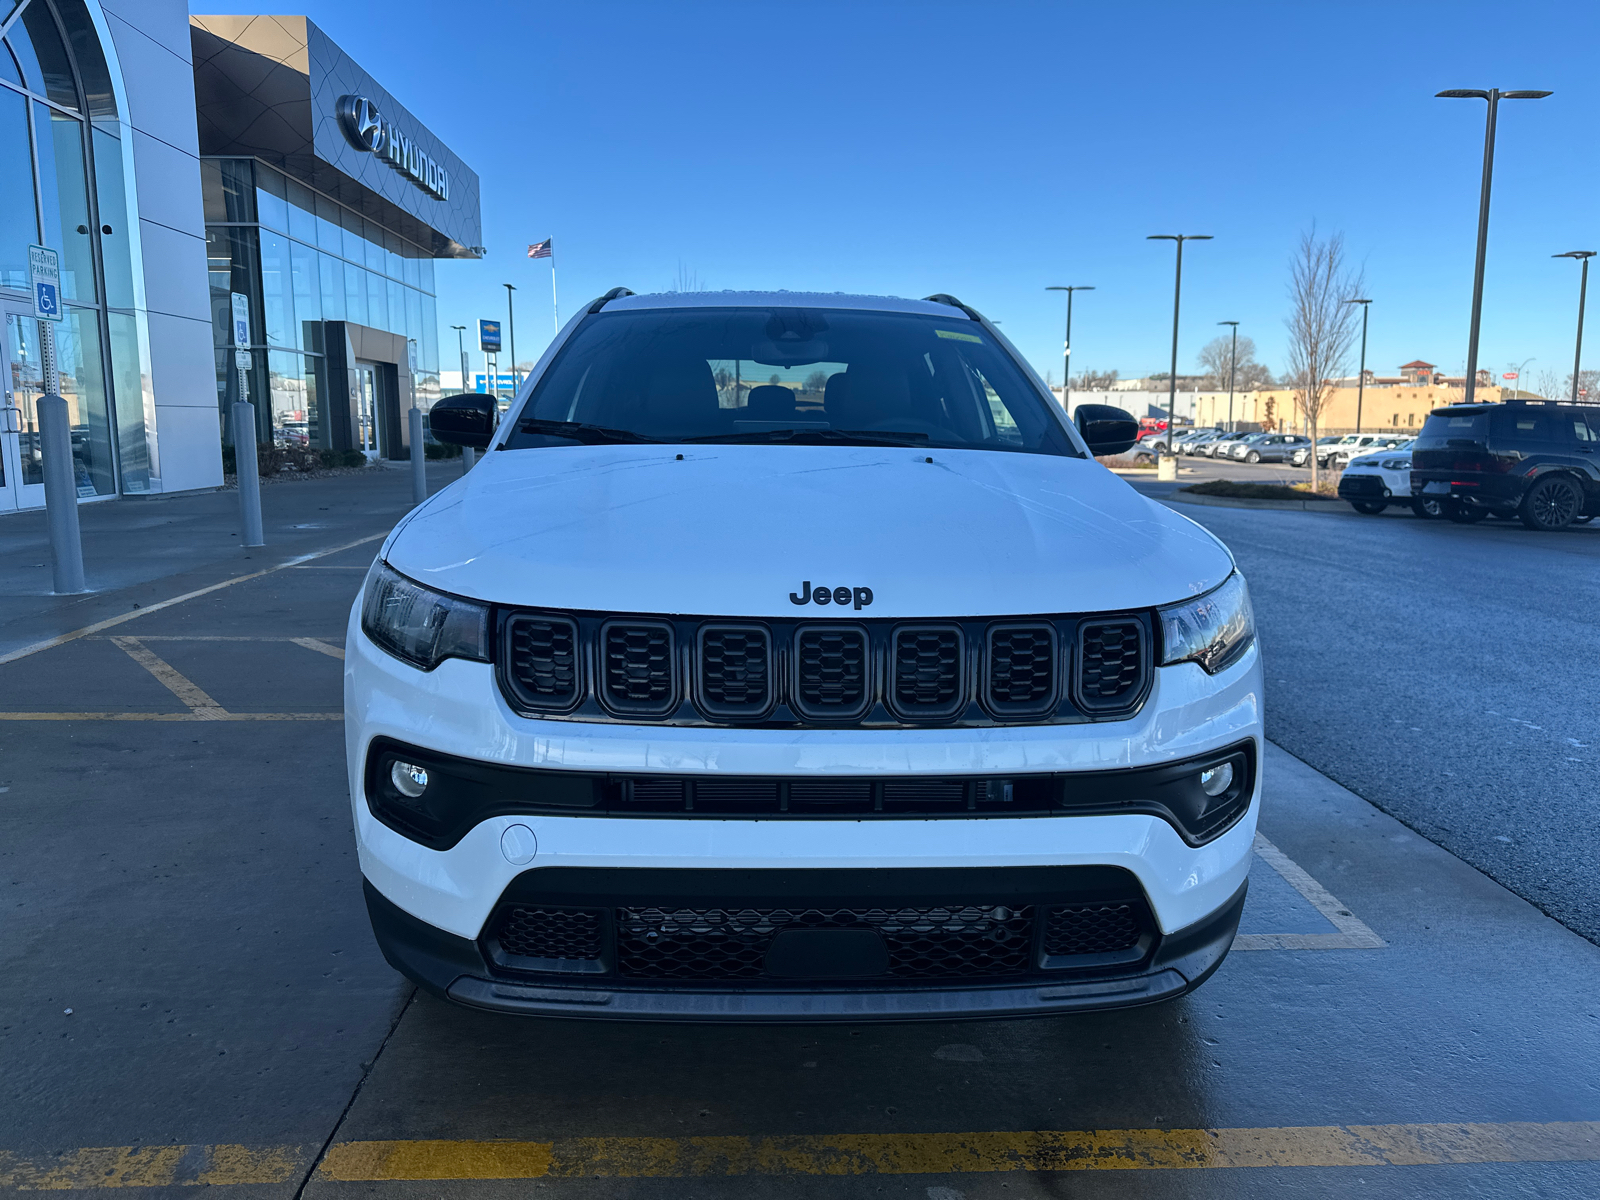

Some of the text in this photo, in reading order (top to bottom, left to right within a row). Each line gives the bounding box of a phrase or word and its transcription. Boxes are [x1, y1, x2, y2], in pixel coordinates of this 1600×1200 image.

[387, 122, 449, 201] HYUNDAI
[31, 252, 56, 265] RESERVED
[32, 264, 57, 278] PARKING
[789, 580, 874, 611] Jeep
